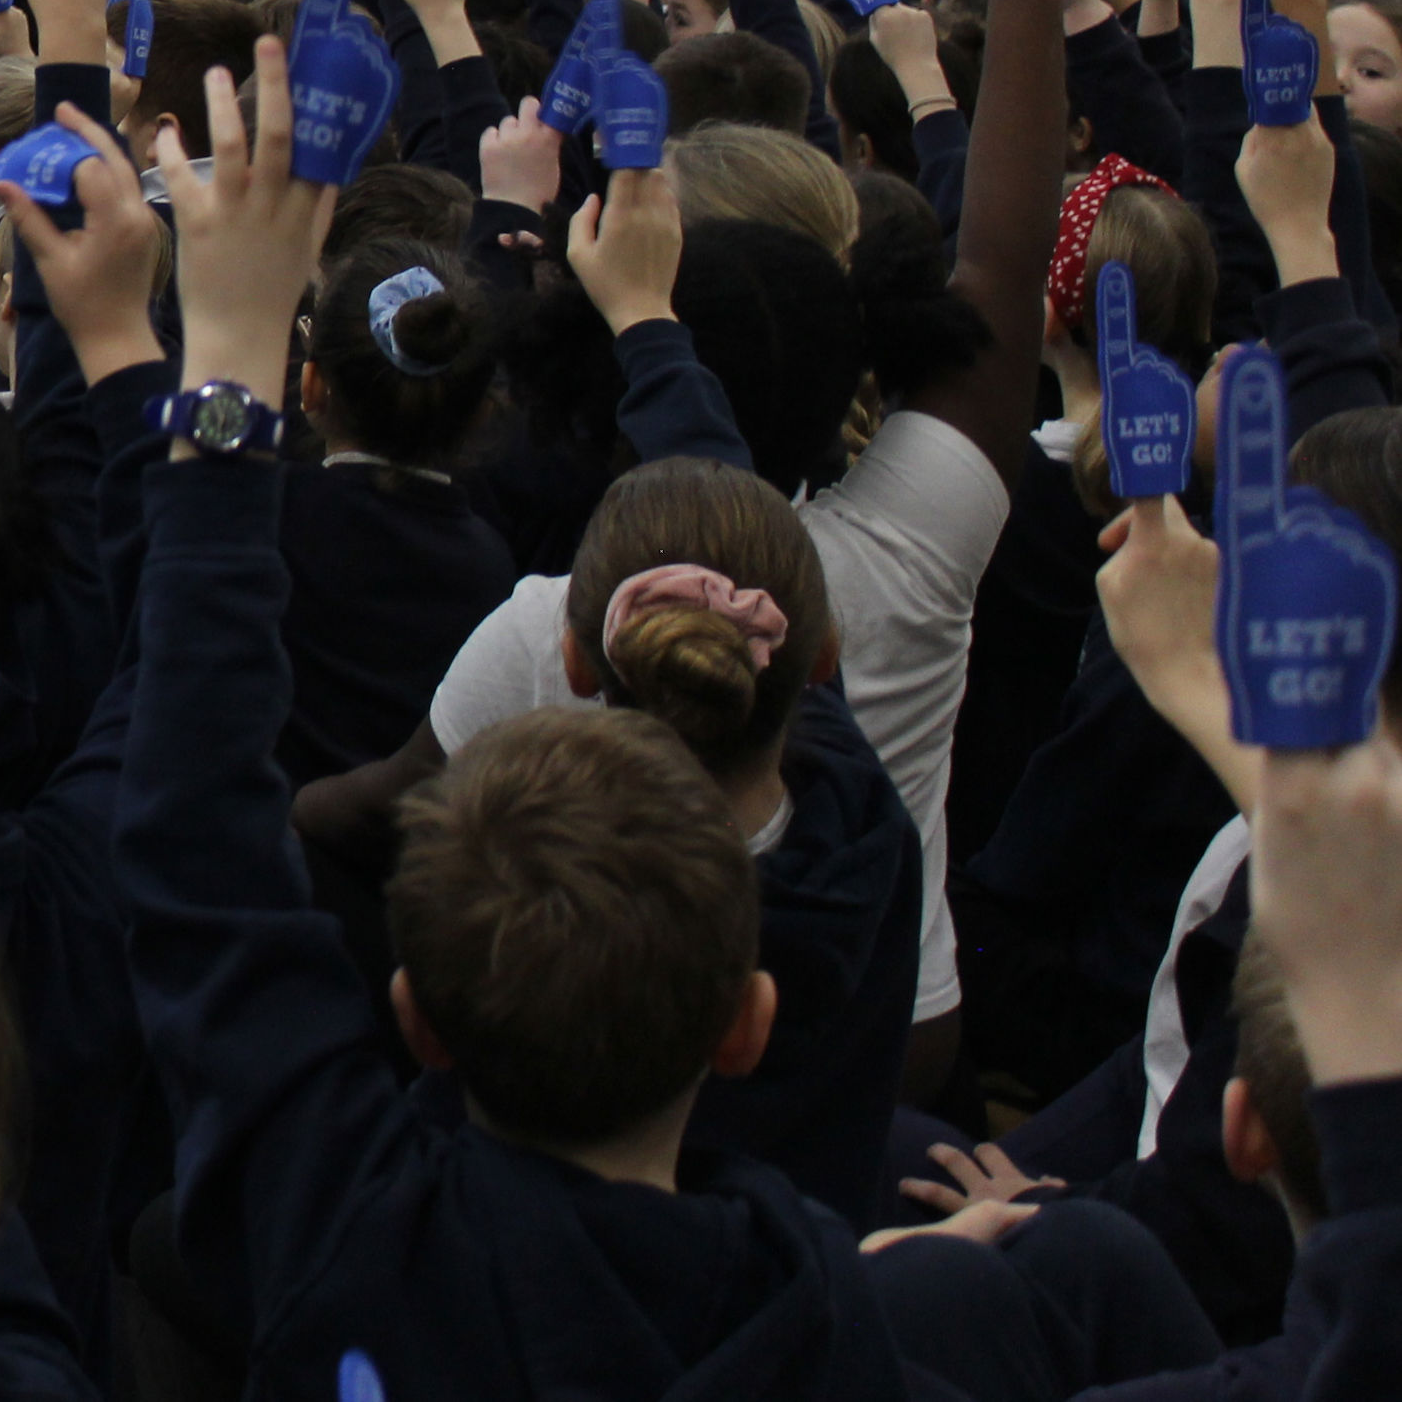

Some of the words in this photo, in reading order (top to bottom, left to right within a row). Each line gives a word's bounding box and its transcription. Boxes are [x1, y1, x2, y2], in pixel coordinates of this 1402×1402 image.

[1256, 63, 1305, 82] LET'S
[1264, 86, 1298, 103] GO!
[1118, 414, 1180, 439] LET'S
[1133, 443, 1172, 465] GO!
[1248, 618, 1365, 656] LET'S
[1269, 666, 1345, 706] GO!
